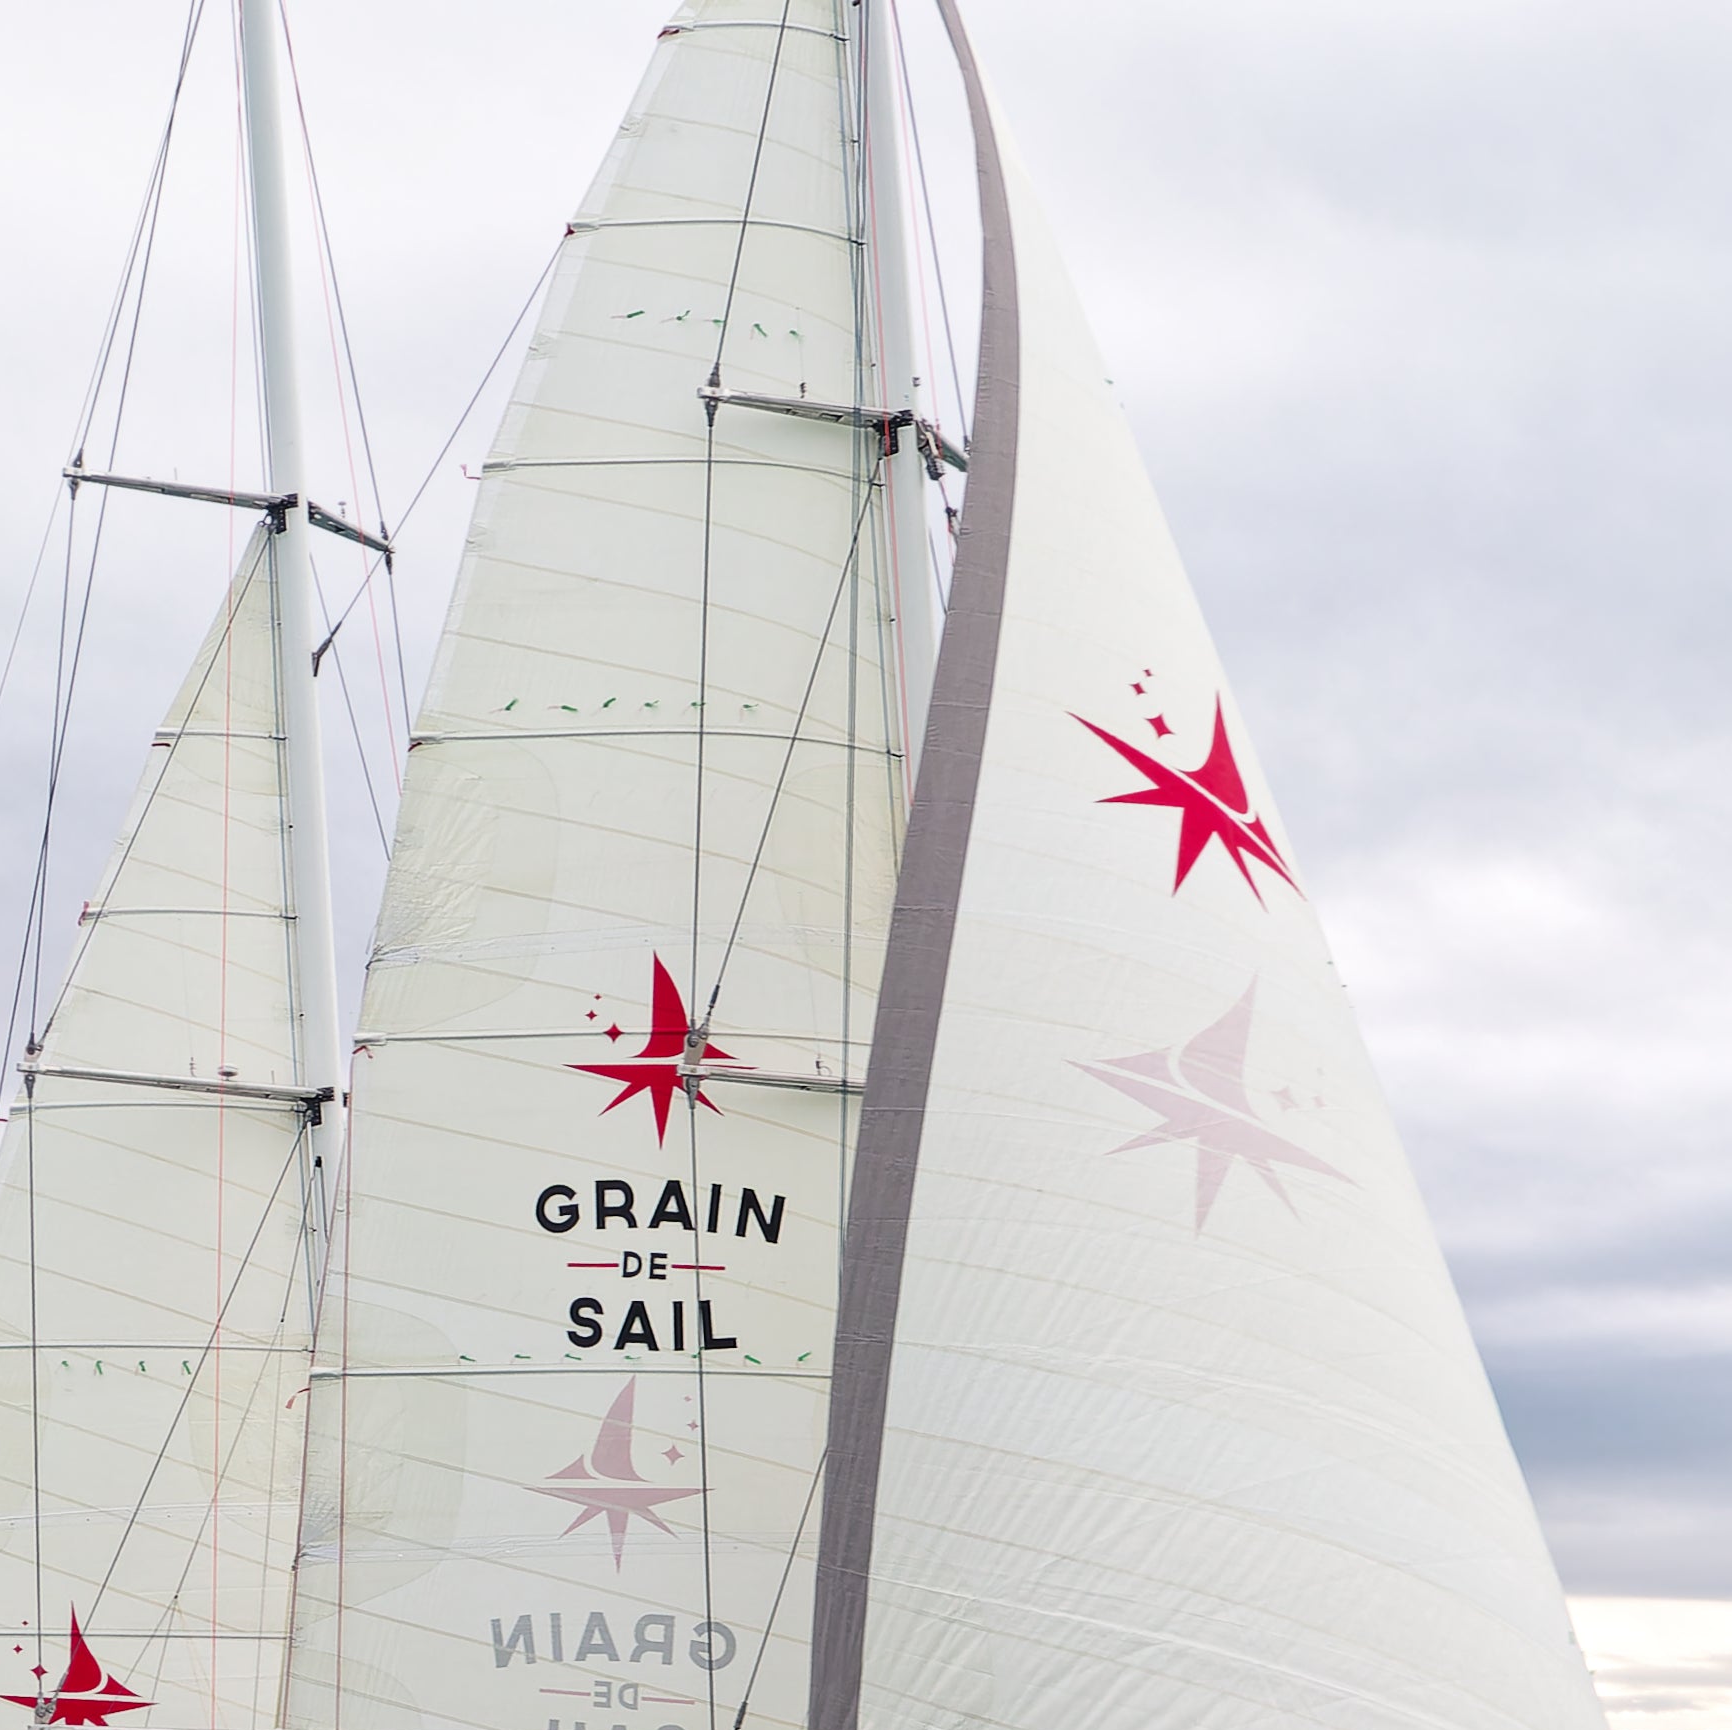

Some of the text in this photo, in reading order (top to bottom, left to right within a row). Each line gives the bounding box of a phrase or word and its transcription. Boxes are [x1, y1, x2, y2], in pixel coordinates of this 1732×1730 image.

[535, 1179, 786, 1244] GRAIN
[622, 1250, 668, 1280] DE
[566, 1297, 738, 1352] SAIL
